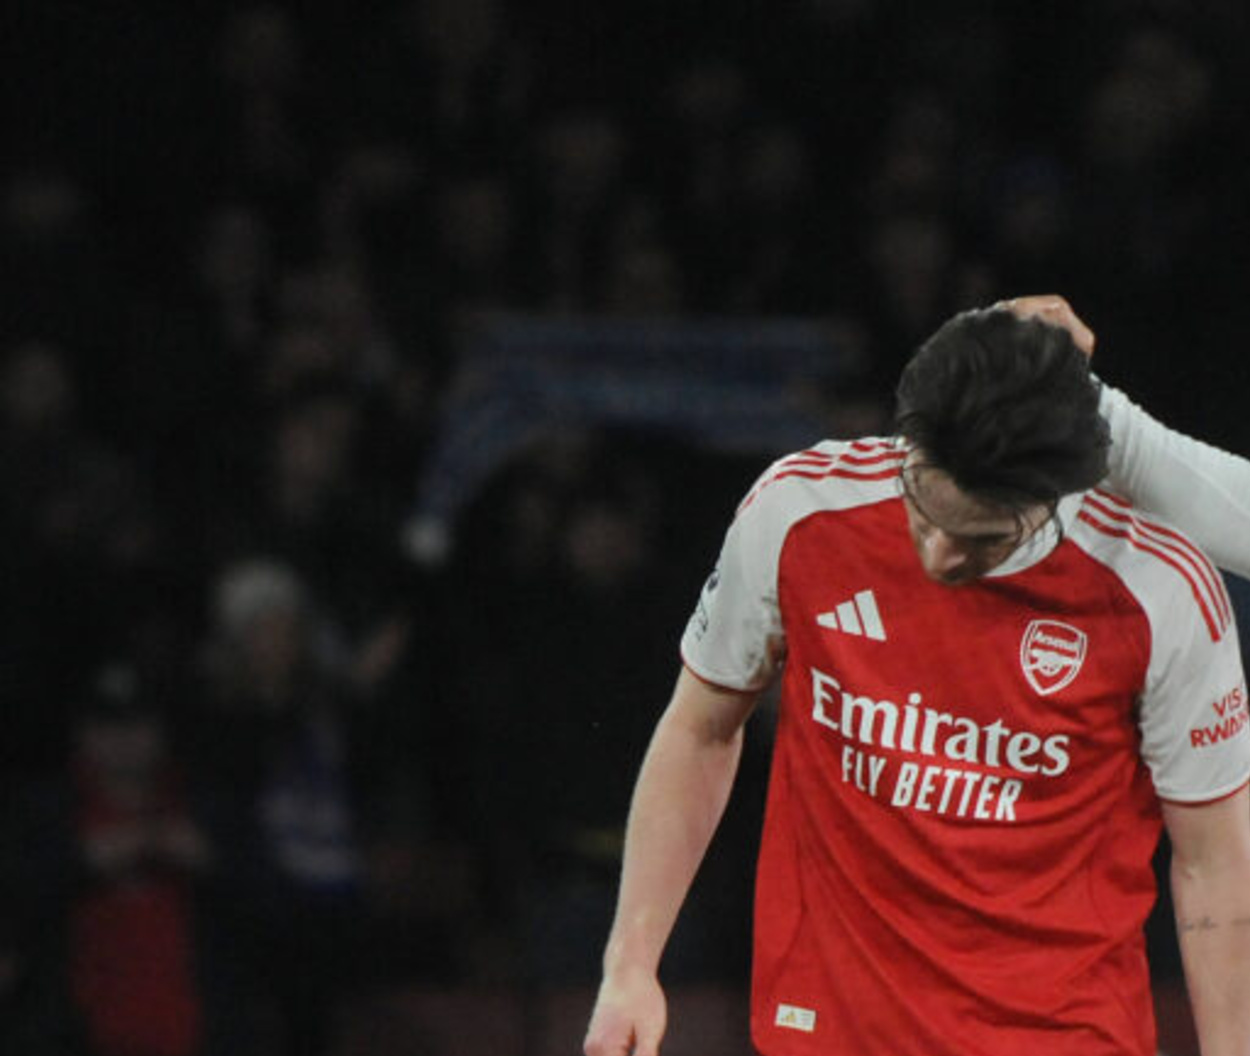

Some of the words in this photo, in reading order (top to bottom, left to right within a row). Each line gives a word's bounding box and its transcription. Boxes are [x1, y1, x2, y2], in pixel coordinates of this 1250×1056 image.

[812, 668, 1070, 776] Emirates
[843, 747, 886, 797] FLY
[893, 763, 1022, 822] BETTER
